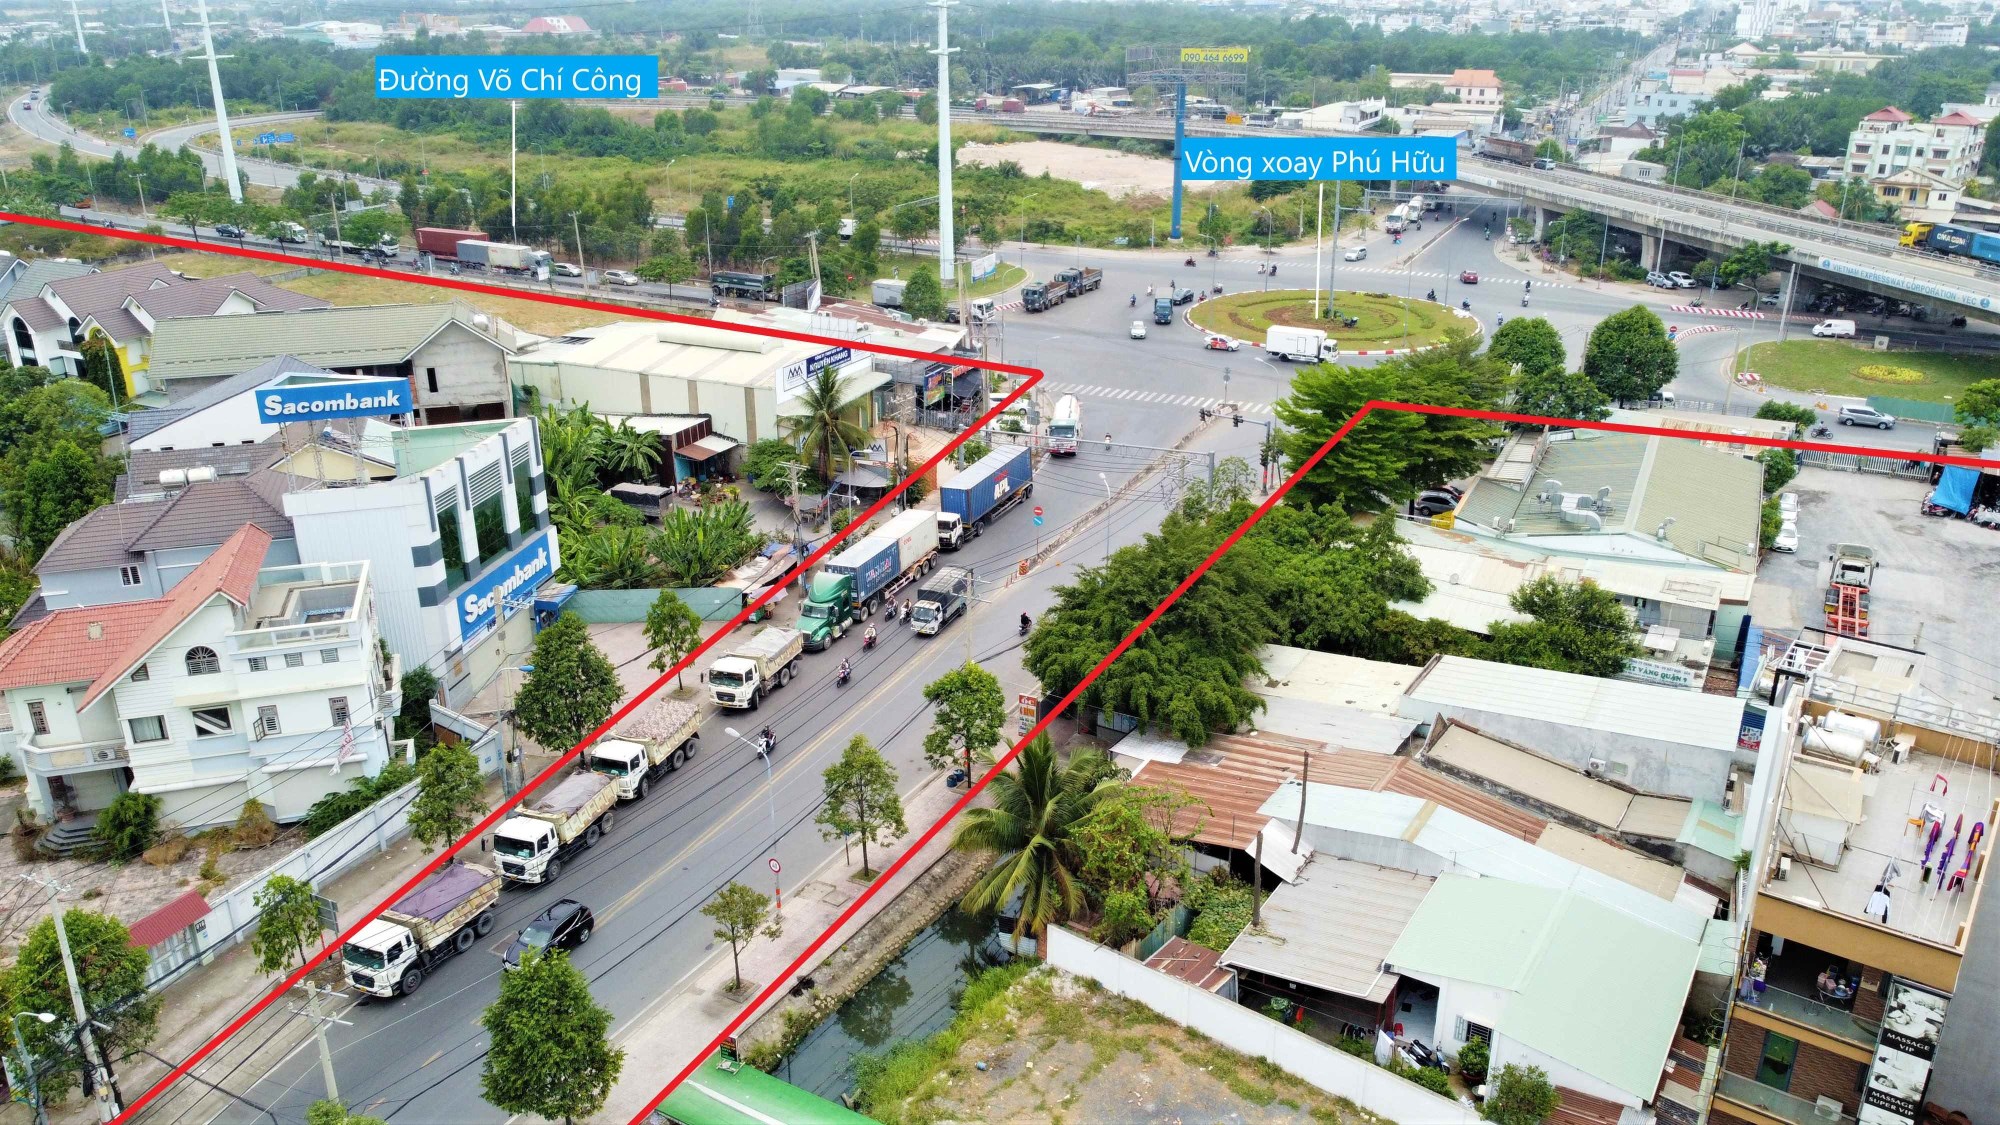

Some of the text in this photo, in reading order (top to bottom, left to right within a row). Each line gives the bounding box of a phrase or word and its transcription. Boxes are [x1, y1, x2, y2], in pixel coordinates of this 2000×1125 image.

[1184, 53, 1244, 62] 090 464 6699
[1936, 232, 1951, 242] CMA
[1832, 263, 1977, 306] VIETNAM EXPRESSWAY CORPORATION VEC
[831, 350, 849, 365] KHANG
[264, 389, 401, 416] Sacombank
[994, 477, 1010, 500] APL
[1638, 667, 1659, 677] VÀNG
[1660, 672, 1682, 682] QUẬN
[1886, 1032, 1931, 1051] MASSAGE
[1899, 1043, 1915, 1053] VIP
[1868, 1096, 1915, 1116] SUPER VIP
[1871, 1090, 1915, 1110] MASSAGE
